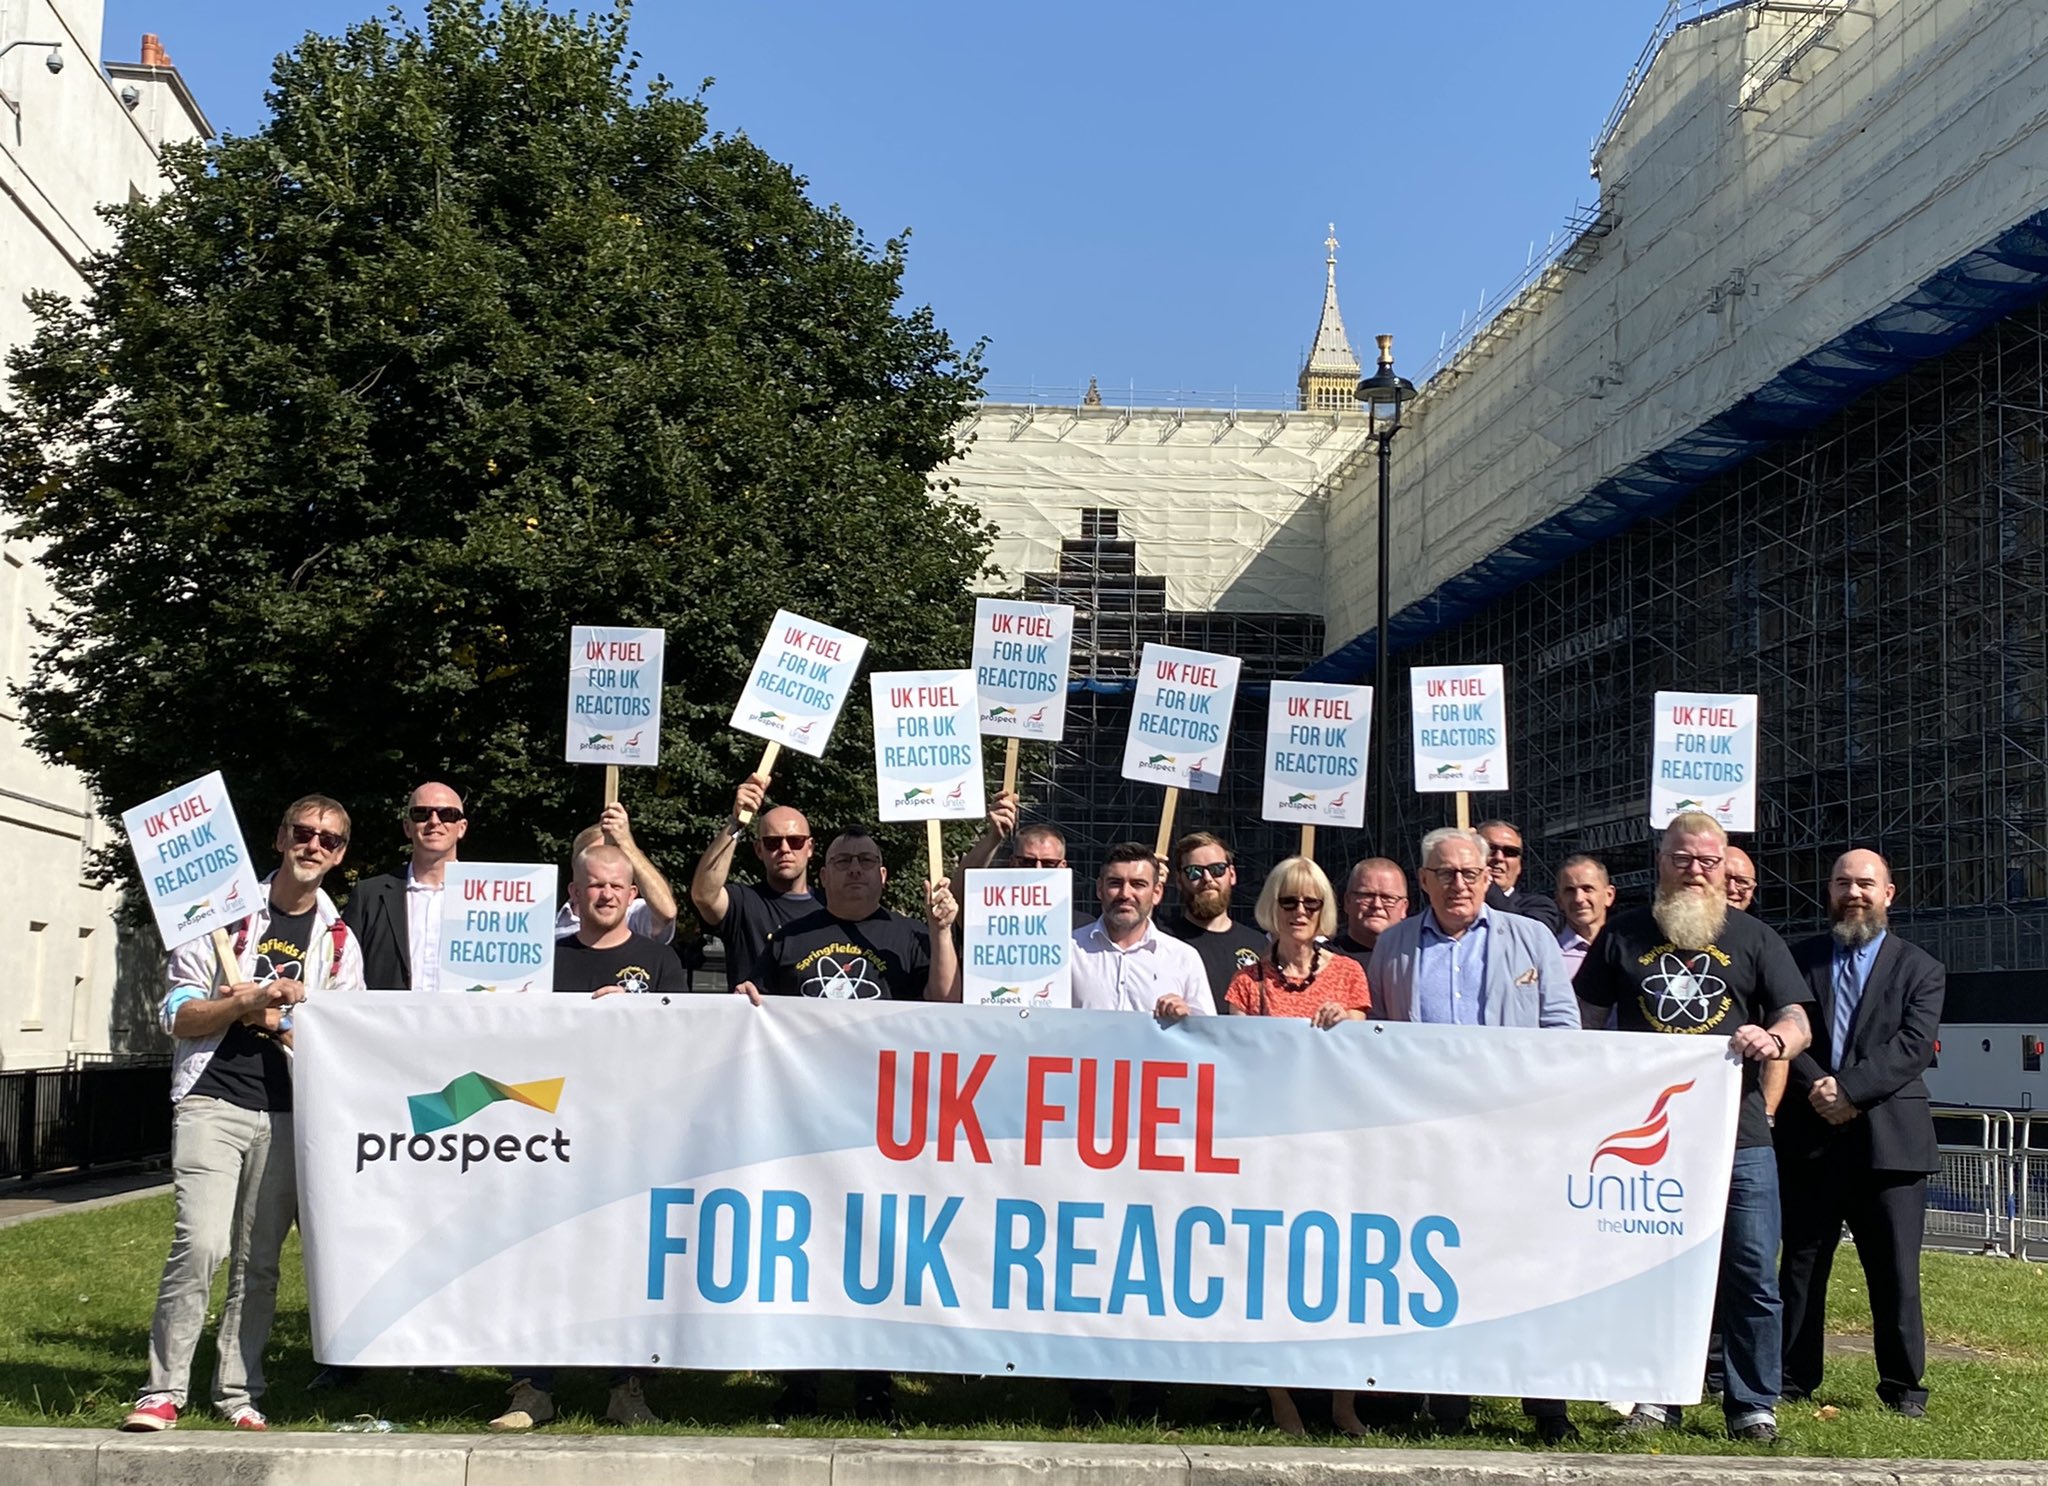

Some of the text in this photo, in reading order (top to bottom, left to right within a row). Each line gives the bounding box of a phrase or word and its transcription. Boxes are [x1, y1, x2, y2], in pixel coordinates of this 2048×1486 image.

[992, 613, 1053, 638] UK FUEL
[586, 641, 645, 661] UK FUEL
[784, 626, 842, 662] UK FUEL
[993, 641, 1048, 664] FOR UK
[589, 668, 639, 688] FOR UK
[777, 651, 832, 684] FOR UK
[978, 666, 1058, 692] REACTORS
[1156, 660, 1218, 688] UK FUEL
[756, 670, 834, 711] REACTORS
[891, 687, 959, 708] UK FUEL
[1427, 679, 1486, 697] UK FUEL
[576, 695, 651, 716] REACTORS
[1156, 688, 1211, 714] FOR UK
[1288, 697, 1352, 720] UK FUEL
[1432, 704, 1483, 721] FOR UK
[749, 714, 784, 730] prospect
[897, 716, 956, 737] FOR UK
[980, 714, 1016, 723] prospect
[1139, 712, 1219, 743] REACTORS
[1673, 706, 1738, 728] UK FUEL
[580, 742, 614, 750] prospect
[1290, 725, 1347, 748] FOR UK
[1421, 728, 1496, 746] REACTORS
[1676, 733, 1732, 755] FOR UK
[885, 745, 971, 767] REACTORS
[1139, 761, 1176, 772] prospect
[1275, 752, 1358, 776] REACTORS
[1661, 760, 1744, 782] REACTORS
[895, 798, 935, 807] prospect
[144, 795, 211, 838] UK FUEL
[157, 822, 217, 864] FOR UK
[154, 844, 239, 897] REACTORS
[464, 879, 535, 903] UK FUEL
[984, 886, 1052, 906] UK FUEL
[177, 908, 216, 931] prospect
[467, 910, 529, 933] FOR UK
[988, 915, 1047, 936] FOR UK
[450, 941, 542, 964] REACTORS
[795, 943, 888, 972] Springfields Fuels
[974, 945, 1061, 965] REACTORS
[981, 996, 1021, 1004] prospect
[1720, 996, 1732, 1012] UK
[876, 1050, 1240, 1174] UK FUEL
[356, 1127, 571, 1174] prospect
[1568, 1170, 1684, 1213] unite
[1598, 1218, 1684, 1235] theUNION
[647, 1188, 1461, 1328] FOR UK REACTORS
